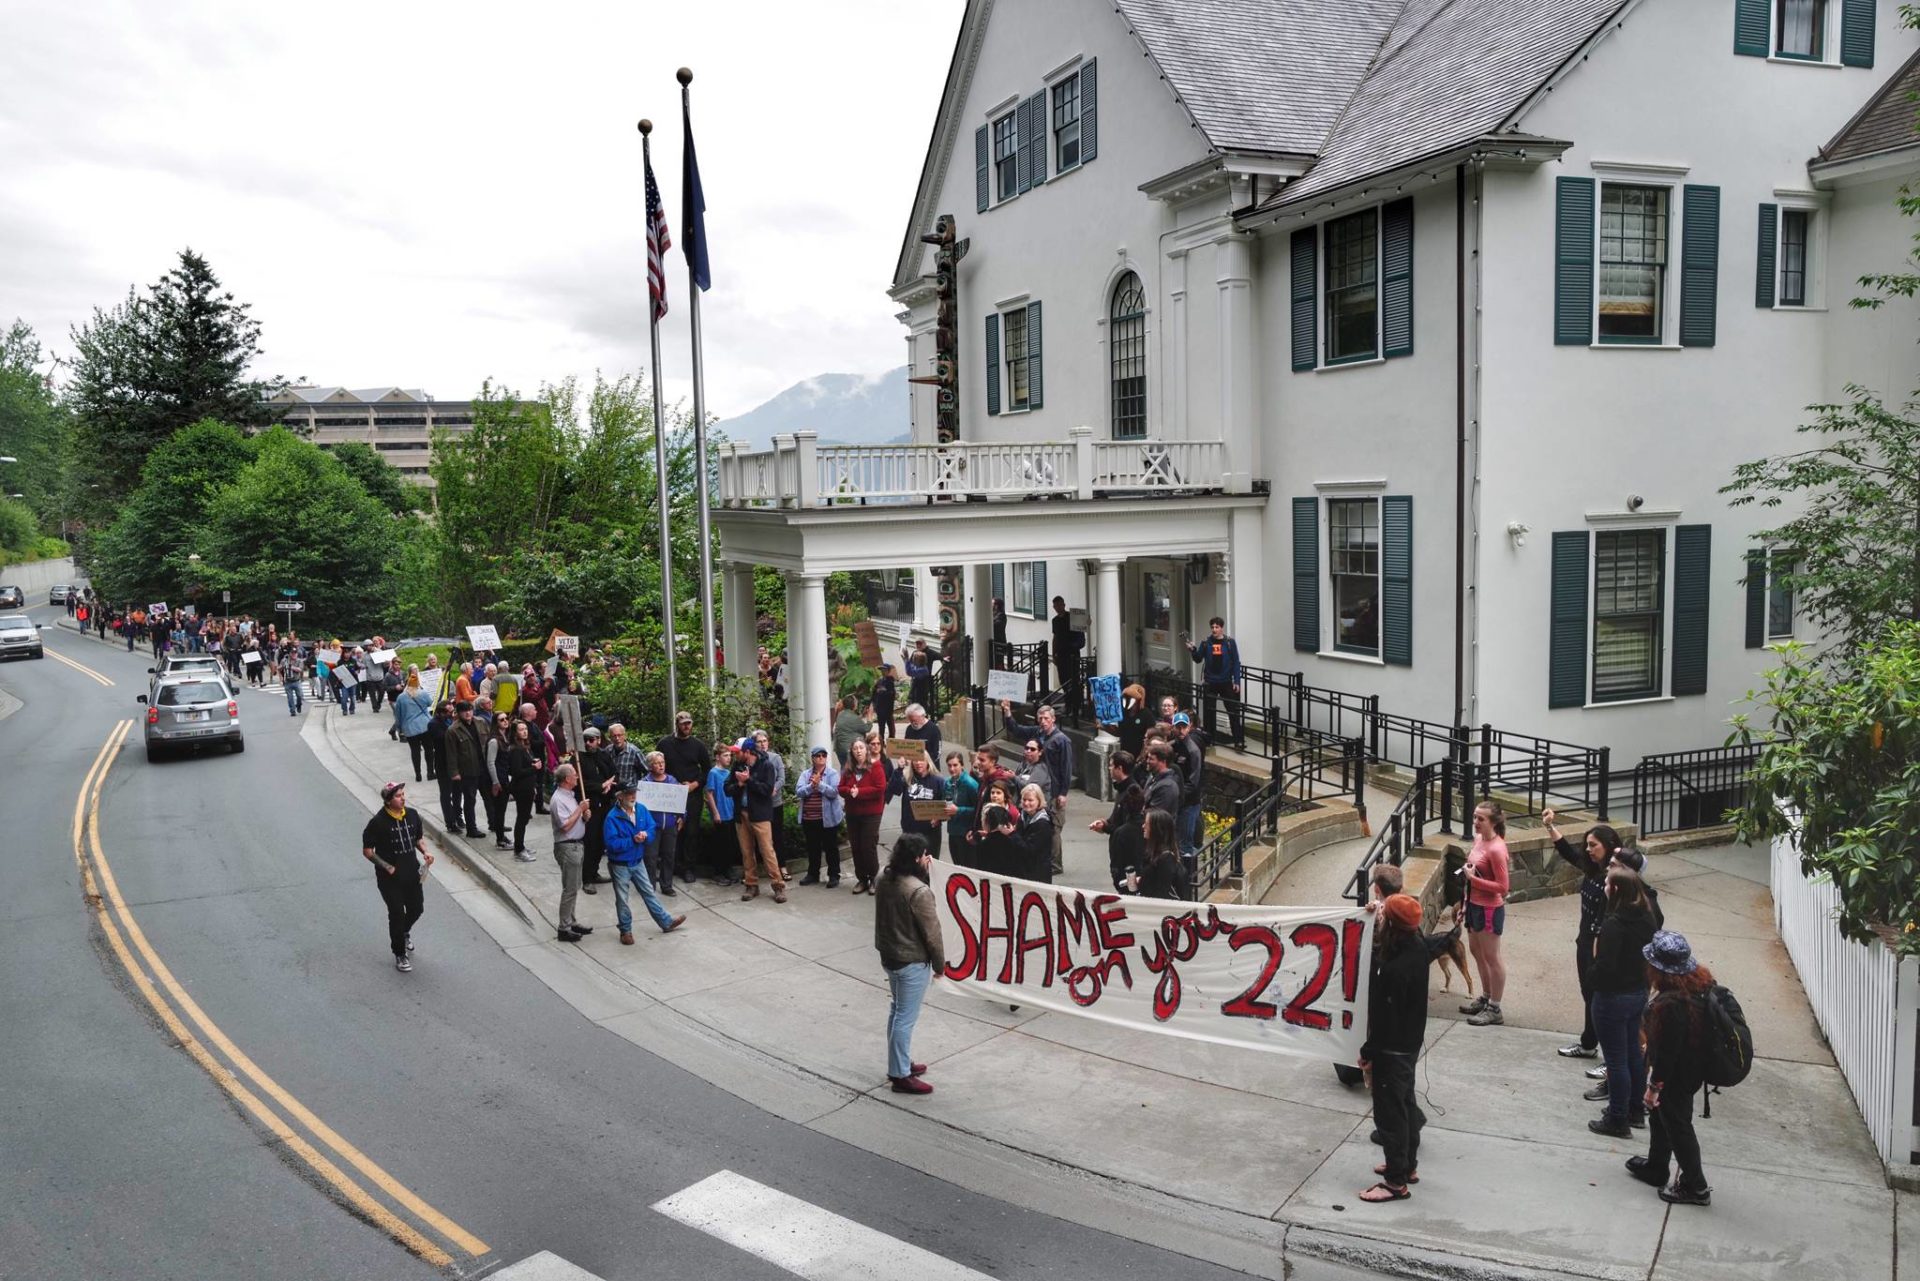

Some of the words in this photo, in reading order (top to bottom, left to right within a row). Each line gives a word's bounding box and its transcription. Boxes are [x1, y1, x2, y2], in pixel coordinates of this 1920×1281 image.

[1095, 703, 1121, 720] SUCK
[944, 873, 1135, 988] SHAME
[1063, 949, 1133, 1007] on
[1140, 904, 1237, 1022] you
[1220, 918, 1366, 1031] 22!
